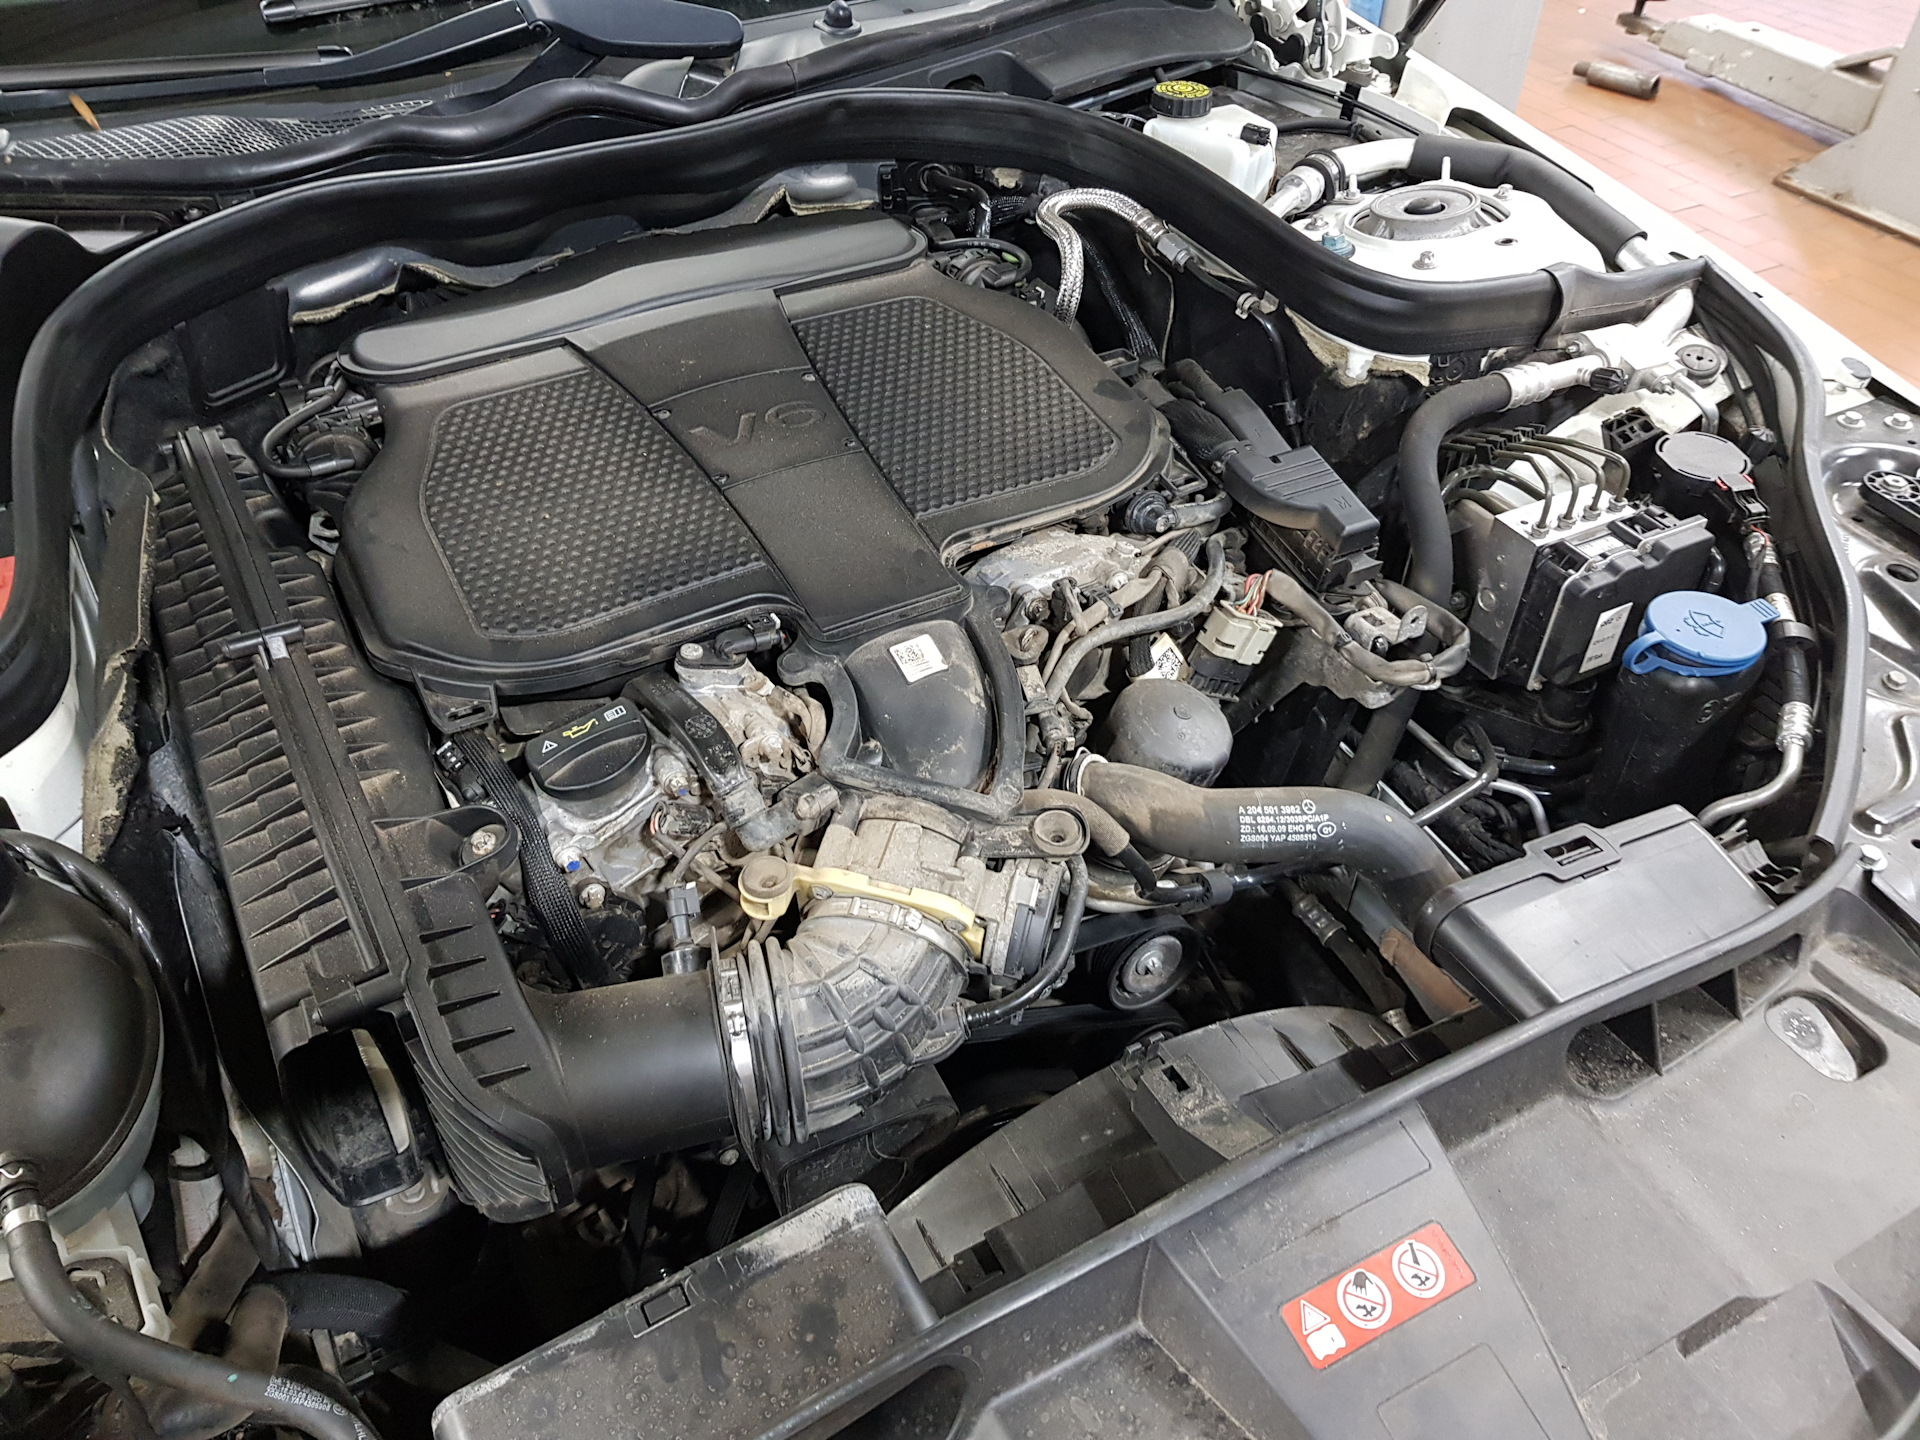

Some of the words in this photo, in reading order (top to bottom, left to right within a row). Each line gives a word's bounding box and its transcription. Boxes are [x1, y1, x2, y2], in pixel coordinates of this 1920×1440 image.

[687, 401, 827, 447] V6
[1239, 806, 1247, 815] A
[1247, 806, 1262, 815] 204
[1264, 806, 1279, 815] 501
[1240, 816, 1256, 824] DBL
[1305, 823, 1317, 832] PL
[1269, 834, 1287, 843] YAP
